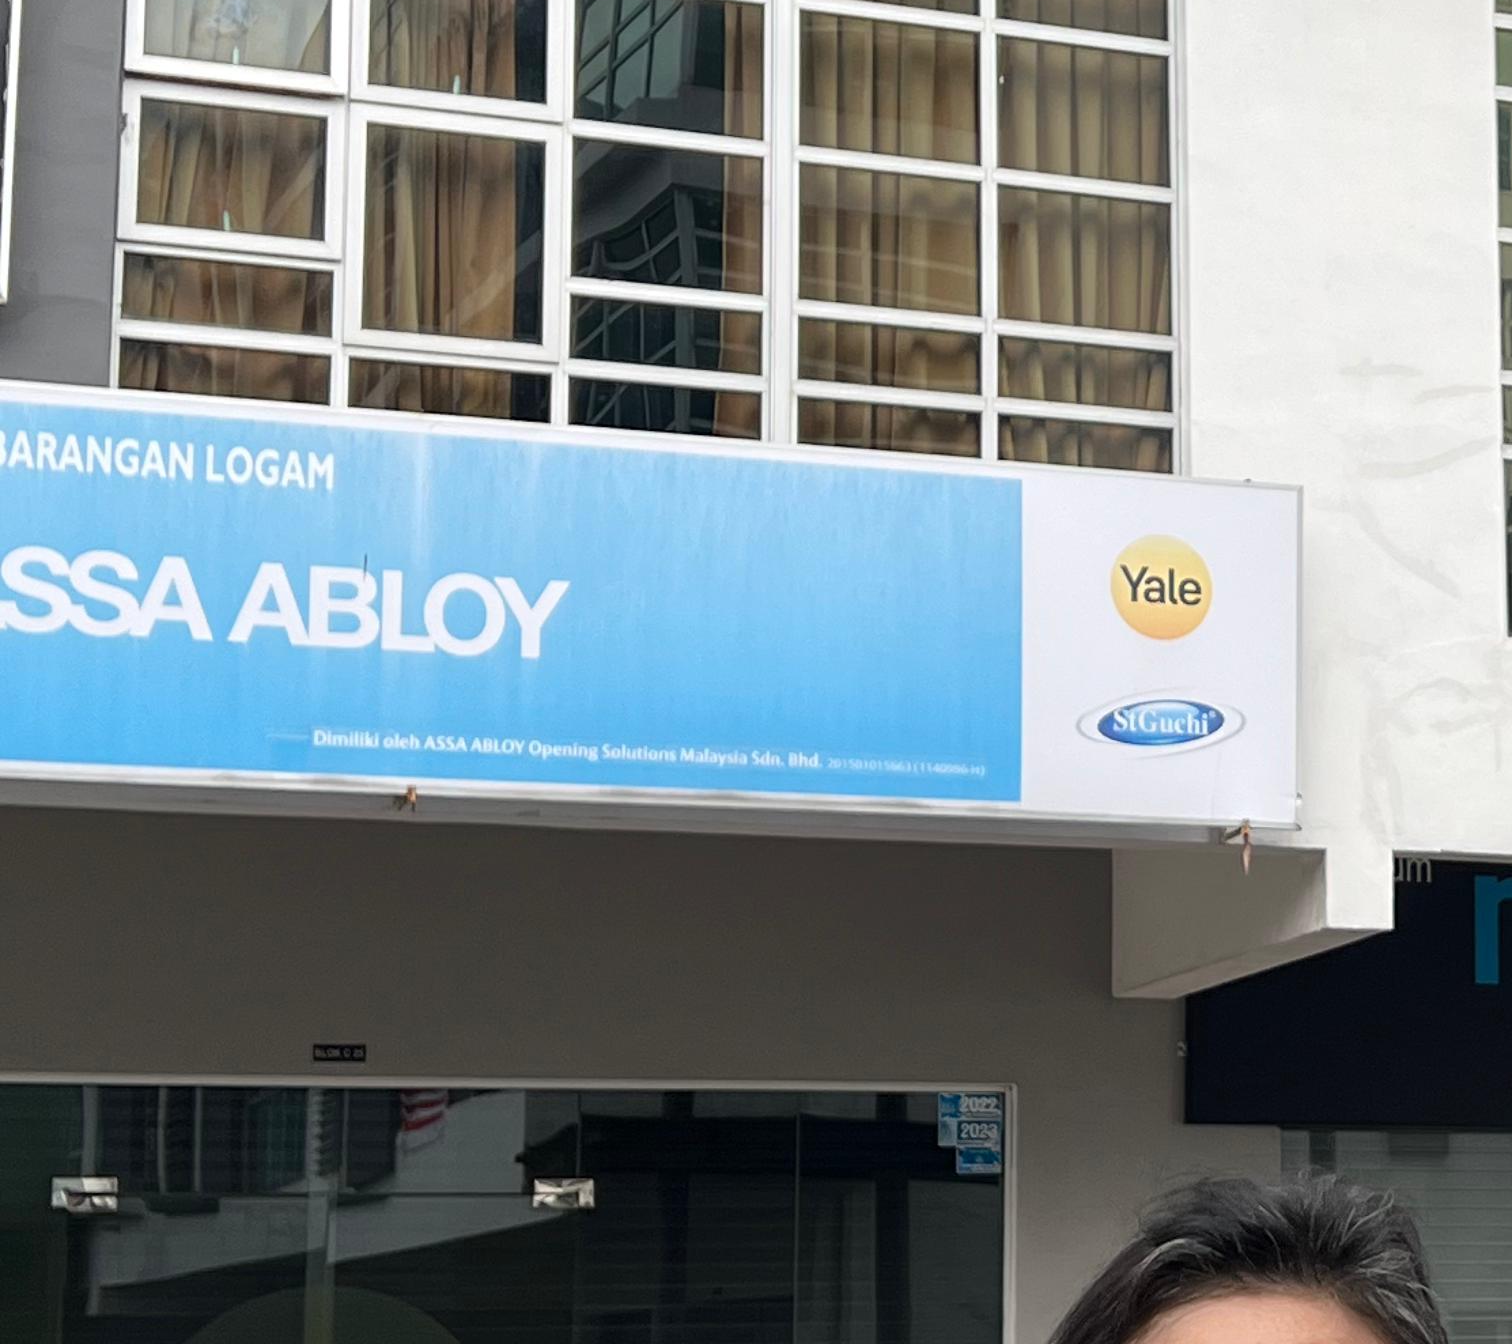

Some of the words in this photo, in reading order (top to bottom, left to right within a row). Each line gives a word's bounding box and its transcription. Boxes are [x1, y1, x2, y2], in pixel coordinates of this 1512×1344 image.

[206, 443, 335, 491] LOGAM
[0, 544, 213, 643] SSA
[227, 561, 571, 660] ABLOY
[1119, 564, 1202, 606] Yale
[313, 729, 379, 748] Dimiliki
[383, 731, 420, 750] oleh
[424, 735, 467, 752] ASSA
[470, 737, 525, 754] ABLOY
[528, 739, 598, 761] Opening
[602, 743, 677, 763] Solutions
[680, 747, 747, 768] Malaysia
[751, 750, 784, 768] Sdn.
[788, 752, 823, 769] Bhd.
